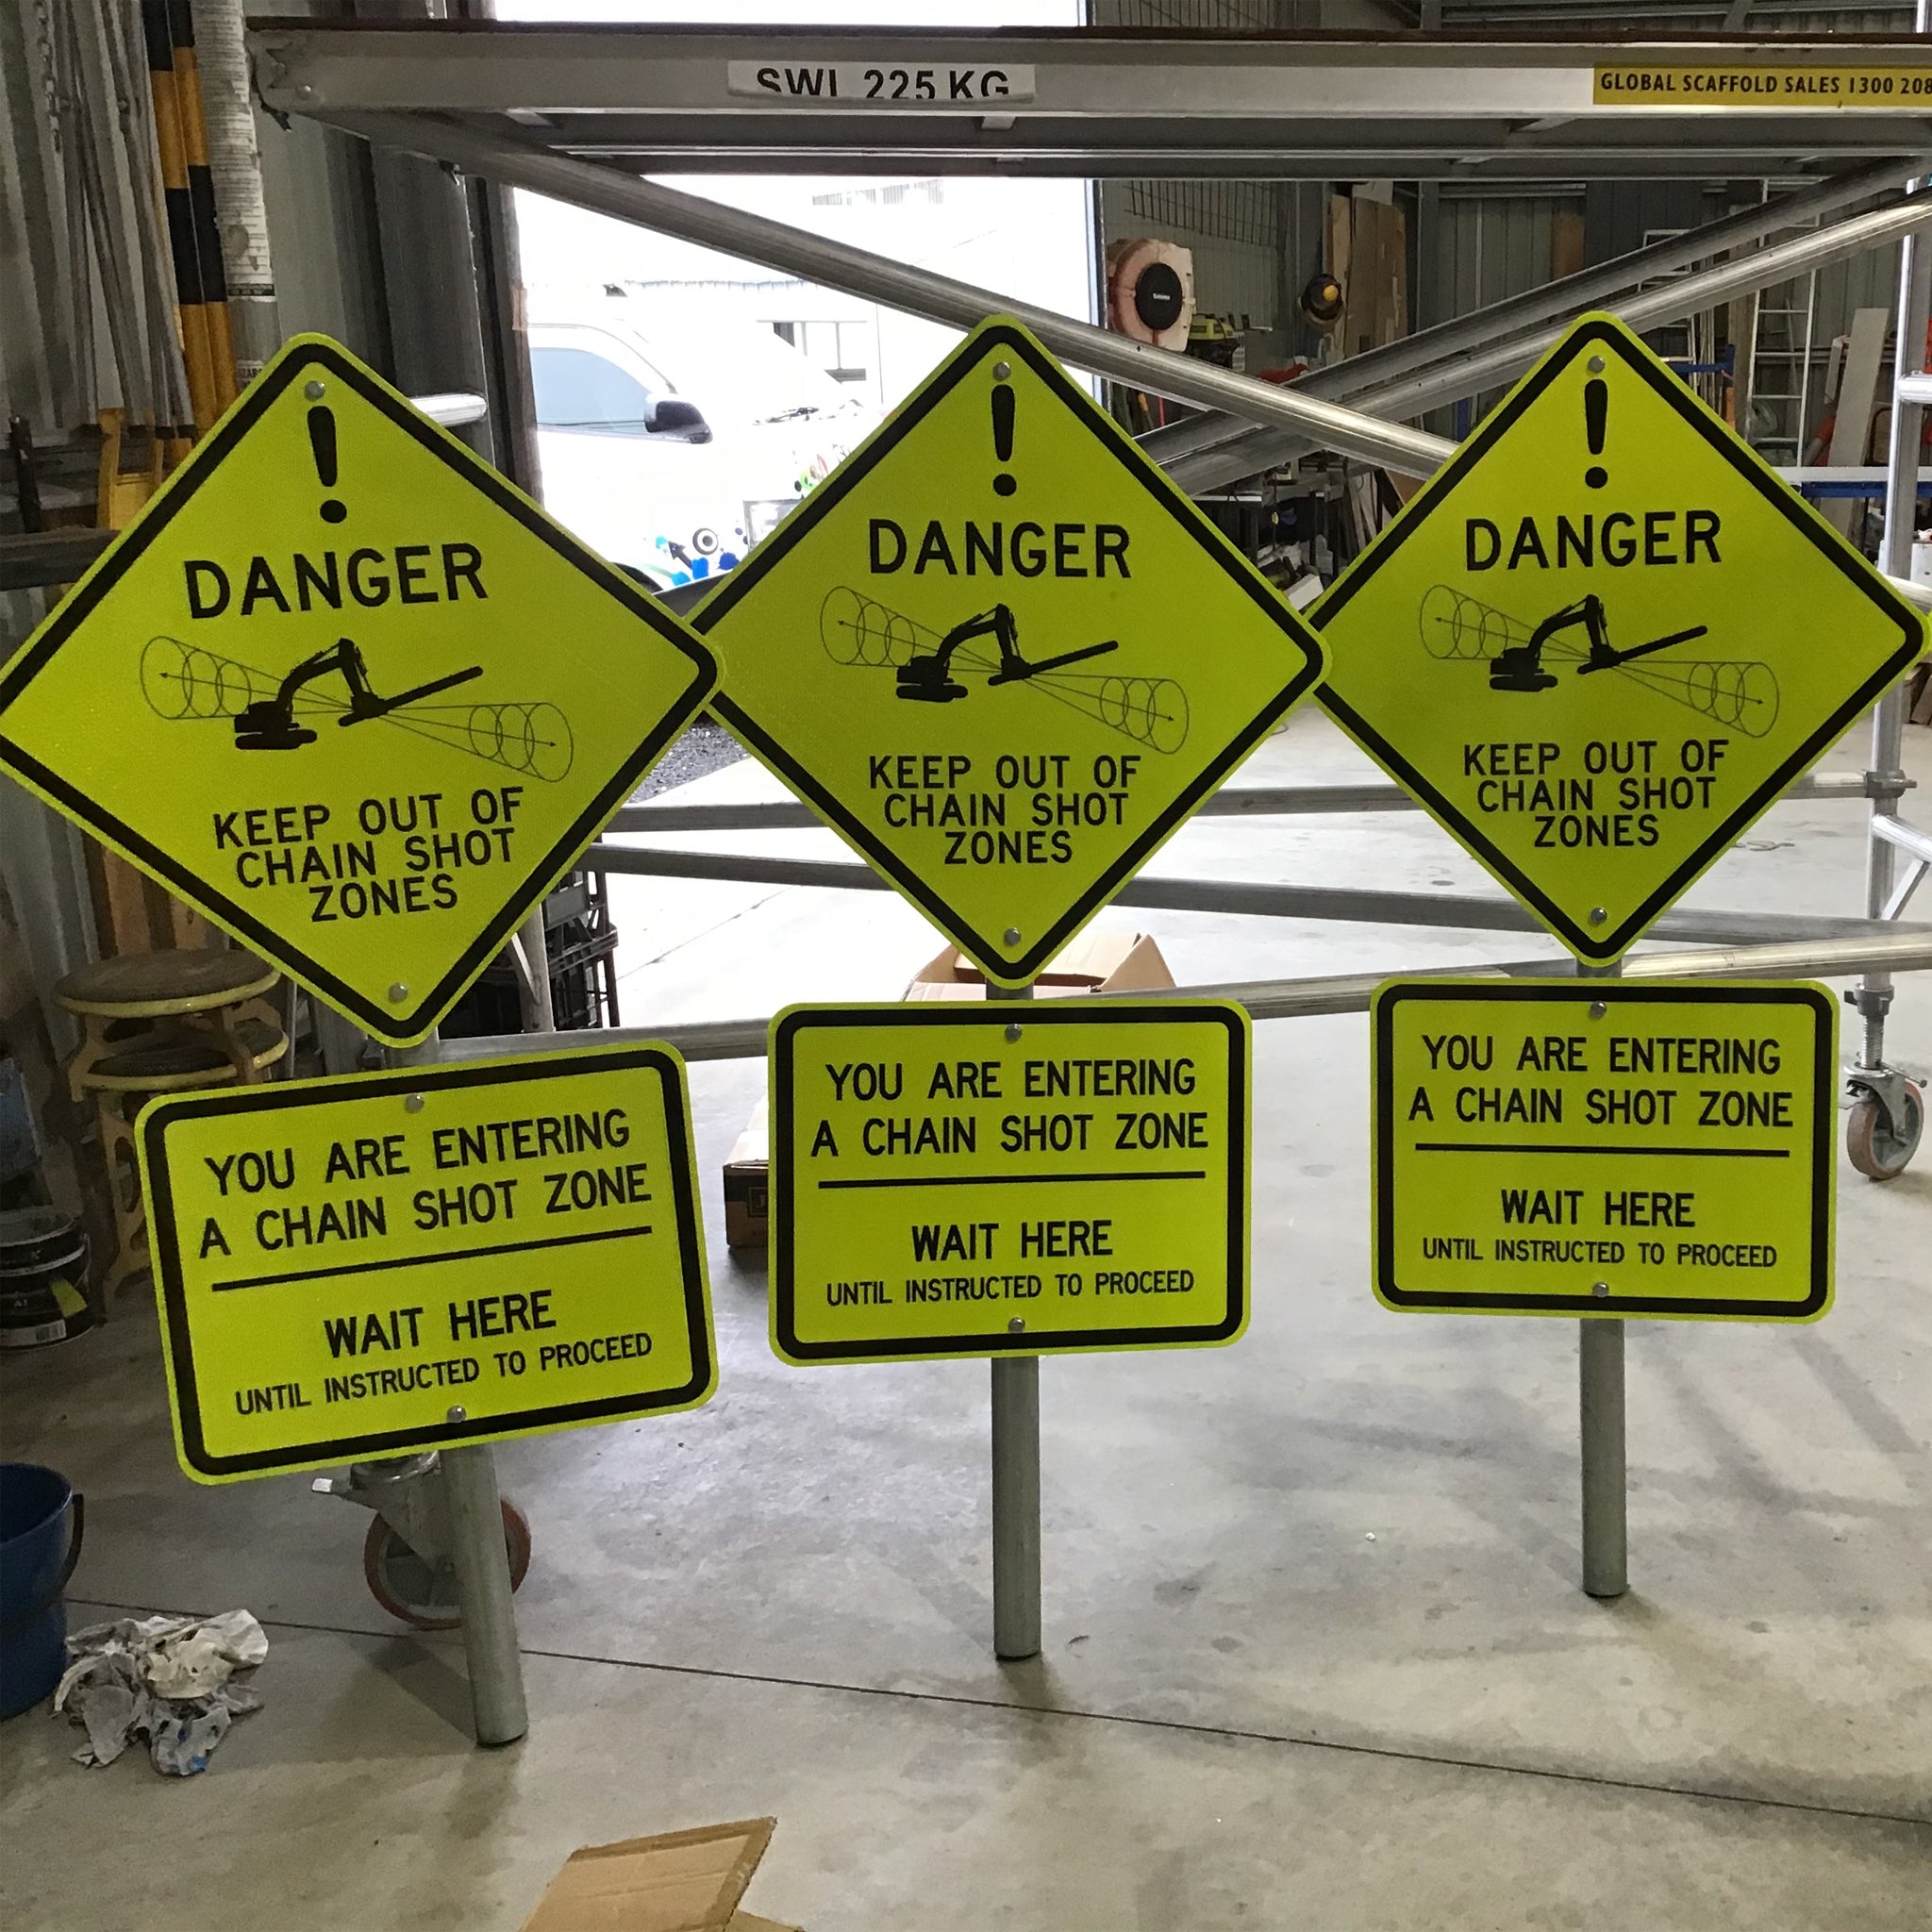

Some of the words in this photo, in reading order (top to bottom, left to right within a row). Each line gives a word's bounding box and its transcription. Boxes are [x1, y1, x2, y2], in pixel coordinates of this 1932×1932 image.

[863, 69, 936, 100] 225
[949, 70, 1009, 99] KG
[1601, 73, 1675, 92] GLOBAL
[1682, 75, 1777, 93] SCAFFOLD
[1785, 75, 1840, 93] SALES
[1849, 76, 1893, 94] 1300
[1900, 77, 1932, 94] 208
[869, 518, 1132, 579] DANGER
[1465, 509, 1723, 572] DANGER
[183, 541, 489, 620] DANGER
[869, 755, 972, 790] KEEP
[995, 754, 1071, 790] OUT
[1092, 754, 1141, 789] OF
[1463, 741, 1561, 776] KEEP
[1583, 740, 1658, 774] OUT
[1680, 739, 1730, 774] OF
[883, 792, 1006, 828] CHAIN
[1031, 791, 1129, 827] SHOT
[1476, 778, 1593, 813] CHAIN
[1618, 775, 1717, 811] SHOT
[212, 804, 331, 850] KEEP
[358, 792, 442, 836] OUT
[471, 786, 525, 825] OF
[1533, 813, 1659, 848] ZONES
[236, 840, 376, 889] CHAIN
[405, 826, 515, 873] SHOT
[943, 829, 1074, 865] ZONES
[308, 873, 458, 923] ZONES
[1421, 1034, 1493, 1072] YOU
[1516, 1036, 1589, 1073] ARE
[1609, 1037, 1781, 1075] ENTERING
[824, 1062, 903, 1102] YOU
[926, 1060, 1003, 1100] ARE
[1024, 1058, 1196, 1098] ENTERING
[1407, 1086, 1435, 1123] A
[1455, 1086, 1562, 1124] CHAIN
[1585, 1088, 1677, 1126] SHOT
[1697, 1090, 1793, 1128] ZONE
[204, 1147, 295, 1196] YOU
[325, 1134, 410, 1184] ARE
[432, 1108, 630, 1170] ENTERING
[810, 1119, 840, 1158] A
[862, 1116, 976, 1157] CHAIN
[1000, 1113, 1094, 1154] SHOT
[1114, 1111, 1208, 1150] ZONE
[199, 1217, 232, 1259] A
[256, 1196, 387, 1251] CHAIN
[412, 1178, 518, 1231] SHOT
[543, 1162, 652, 1214] ZONE
[1500, 1189, 1585, 1225] WAIT
[1604, 1191, 1696, 1228] HERE
[911, 1223, 1000, 1263] WAIT
[1021, 1219, 1113, 1258] HERE
[1423, 1237, 1484, 1260] UNTIL
[1495, 1239, 1625, 1264] INSTRUCTED
[1637, 1241, 1665, 1266] TO
[1676, 1243, 1777, 1268] PROCEED
[826, 1280, 893, 1307] UNTIL
[906, 1274, 1042, 1304] INSTRUCTED
[1054, 1273, 1083, 1297] TO
[1095, 1269, 1194, 1295] PROCEED
[323, 1307, 425, 1358] WAIT
[448, 1289, 558, 1341] HERE
[235, 1382, 312, 1415] UNTIL
[324, 1357, 480, 1404] INSTRUCTED
[492, 1350, 526, 1377] TO
[539, 1332, 653, 1372] PROCEED
